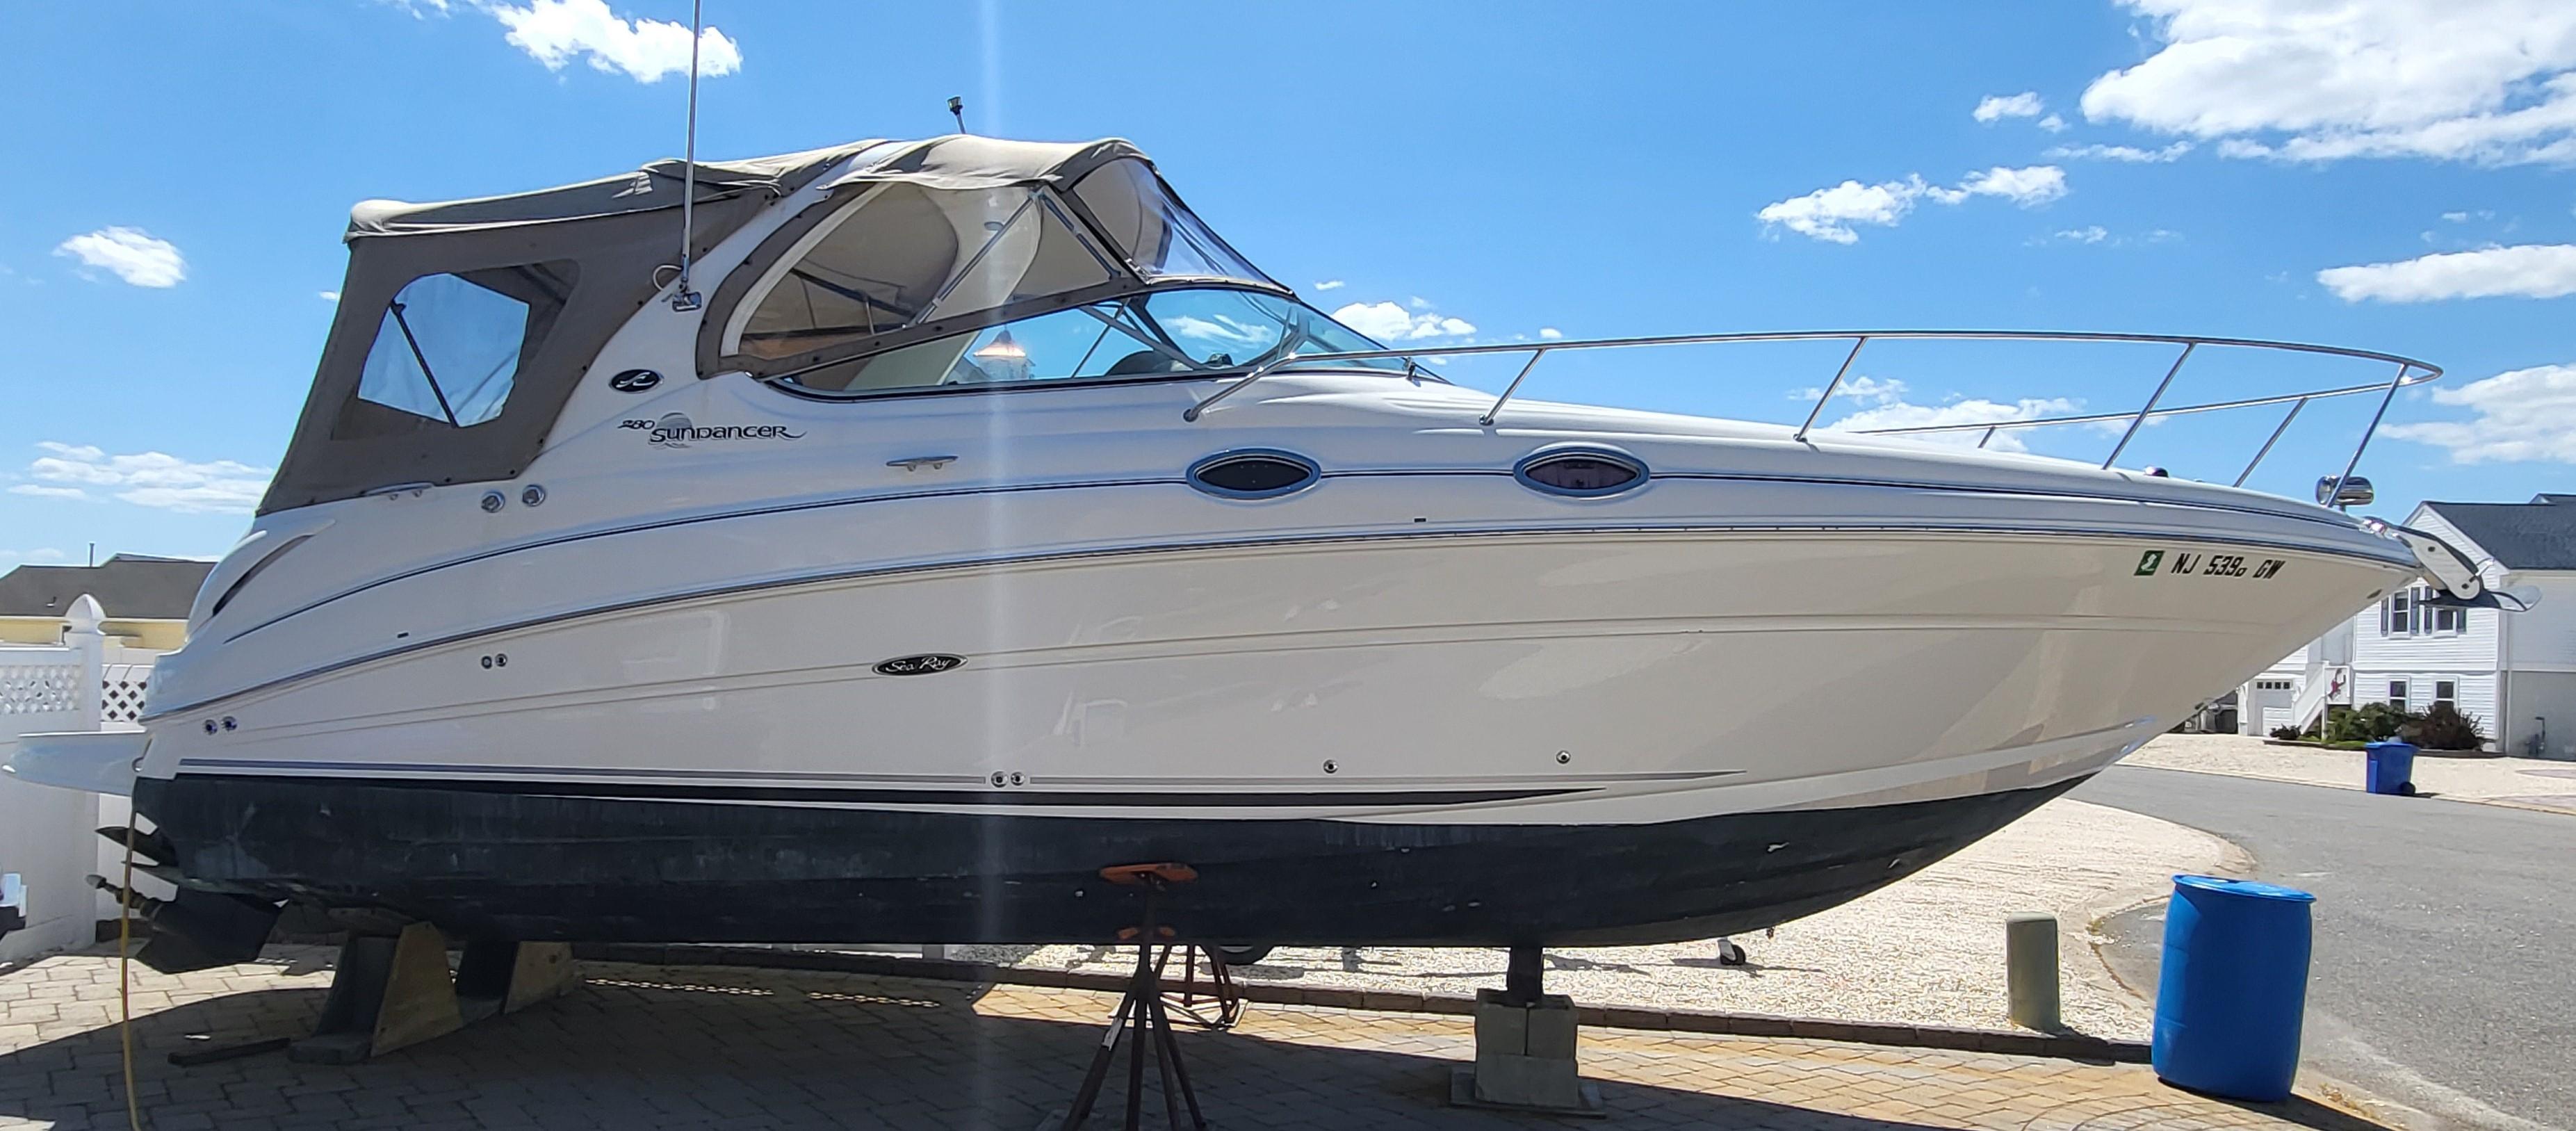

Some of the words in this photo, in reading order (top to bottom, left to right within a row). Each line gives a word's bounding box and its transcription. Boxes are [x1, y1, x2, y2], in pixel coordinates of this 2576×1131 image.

[617, 419, 655, 430] 280
[2171, 553, 2201, 574] NJ
[2252, 559, 2286, 579] GW
[885, 660, 915, 672] Sea
[919, 656, 952, 671] Ray
